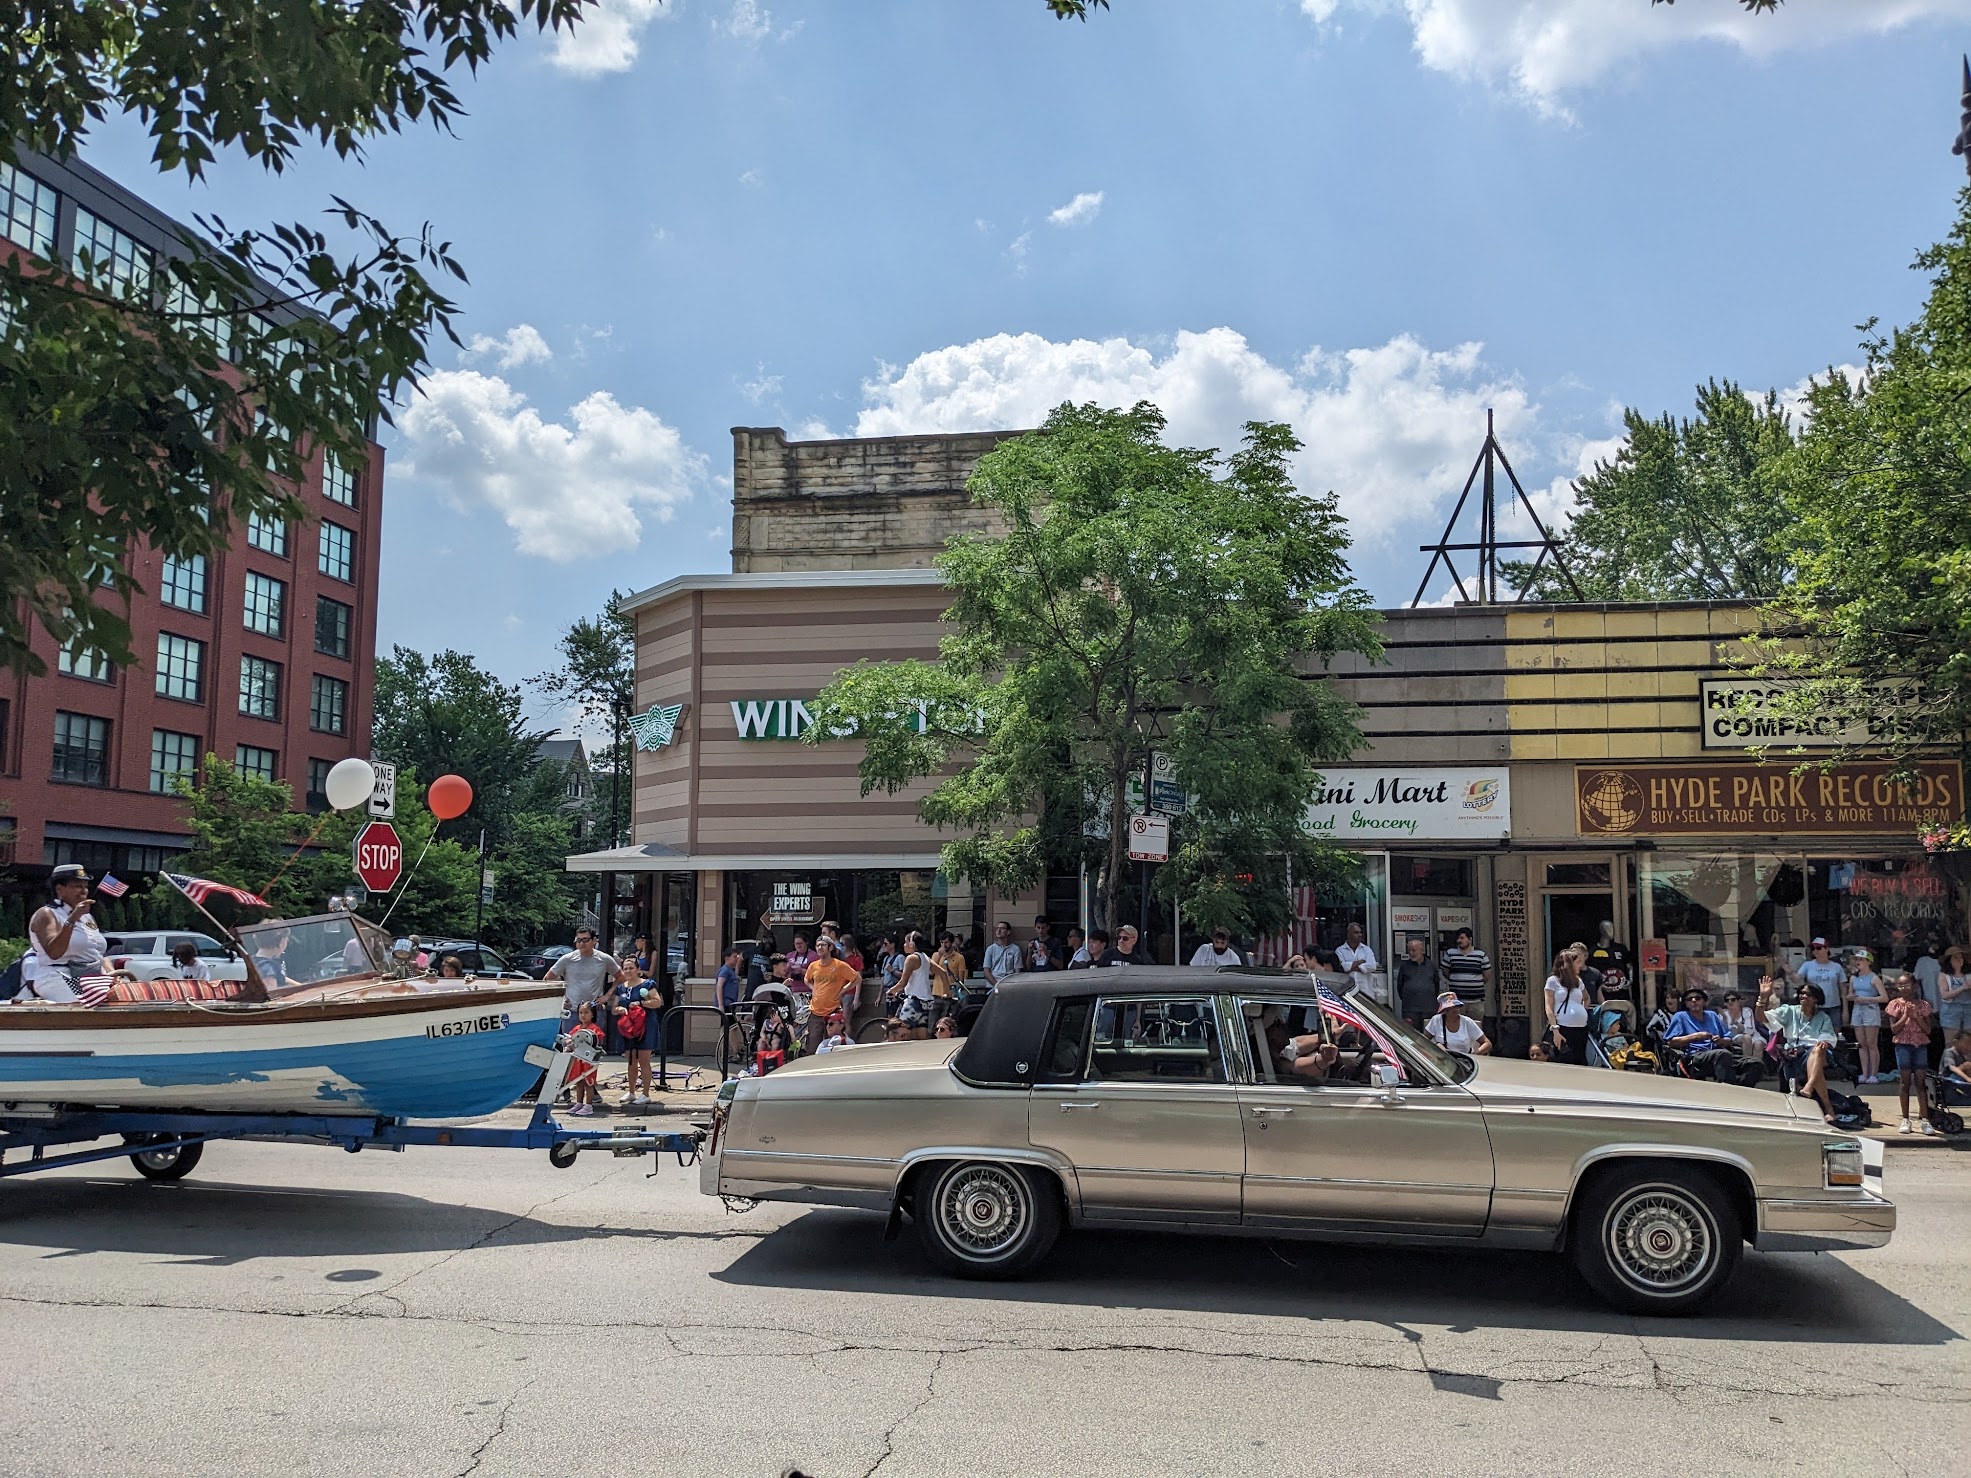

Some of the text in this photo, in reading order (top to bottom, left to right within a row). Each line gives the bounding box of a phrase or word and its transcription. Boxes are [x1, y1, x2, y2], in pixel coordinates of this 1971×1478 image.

[1713, 716, 1850, 737] COMPACT
[374, 765, 392, 781] ONE
[373, 782, 393, 796] WAY
[1316, 777, 1449, 805] ini Mart
[1650, 773, 1952, 809] HYDE PARK RECORDS
[1462, 789, 1499, 809] LOTTERY
[1350, 810, 1419, 835] Grocery
[1763, 809, 1787, 823] CDs
[1795, 809, 1817, 823] LPs
[1825, 809, 1834, 822] &
[1838, 808, 1874, 822] MORE
[361, 844, 399, 870] STOP
[773, 883, 811, 896] THE WING
[773, 896, 810, 910] EXPERTS
[1884, 901, 1945, 920] RECORDS
